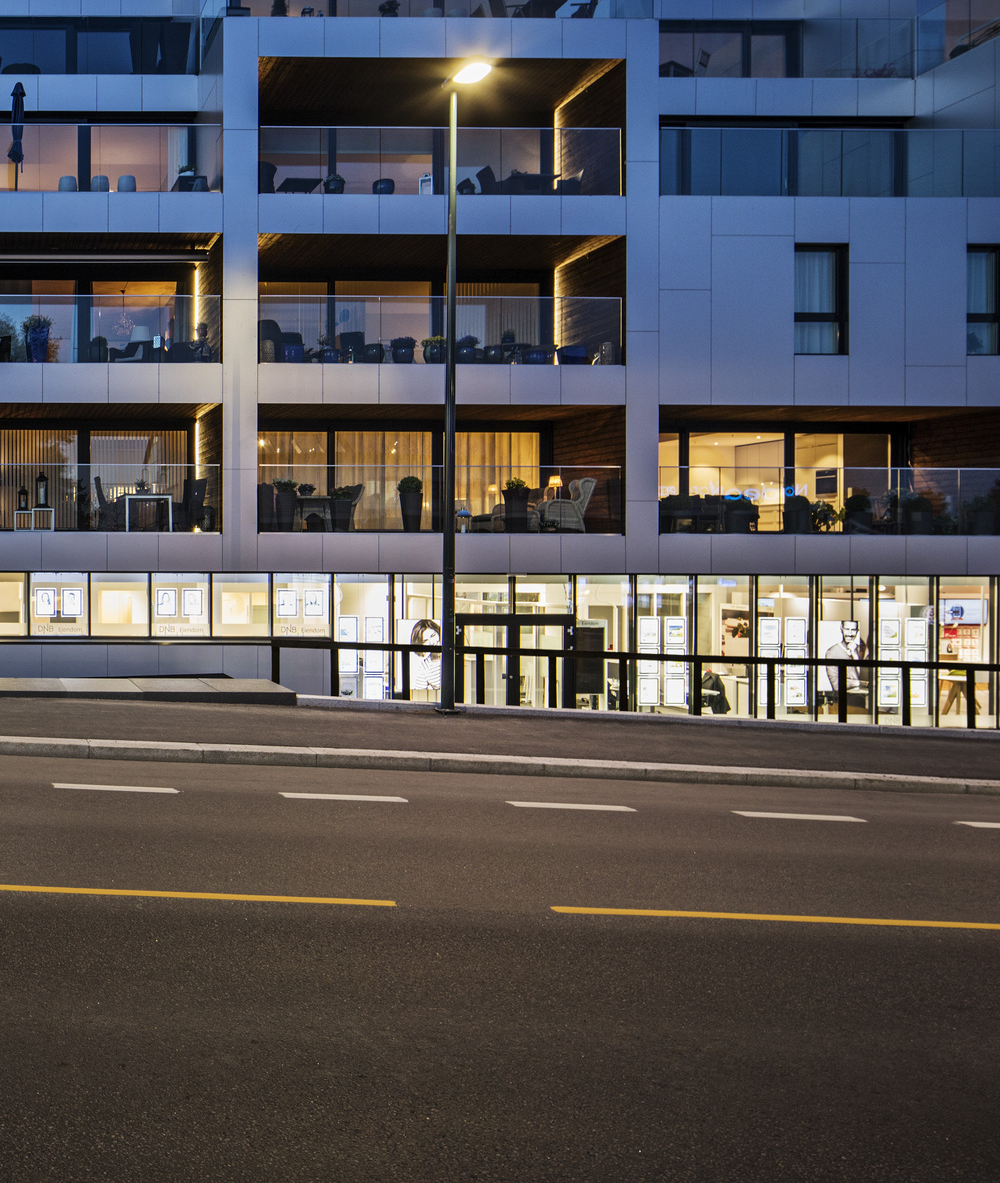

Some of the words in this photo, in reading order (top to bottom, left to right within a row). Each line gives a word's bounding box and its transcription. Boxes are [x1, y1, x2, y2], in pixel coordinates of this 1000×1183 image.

[37, 623, 54, 634] DNB
[159, 623, 176, 635] DNB
[280, 624, 297, 636] DNB
